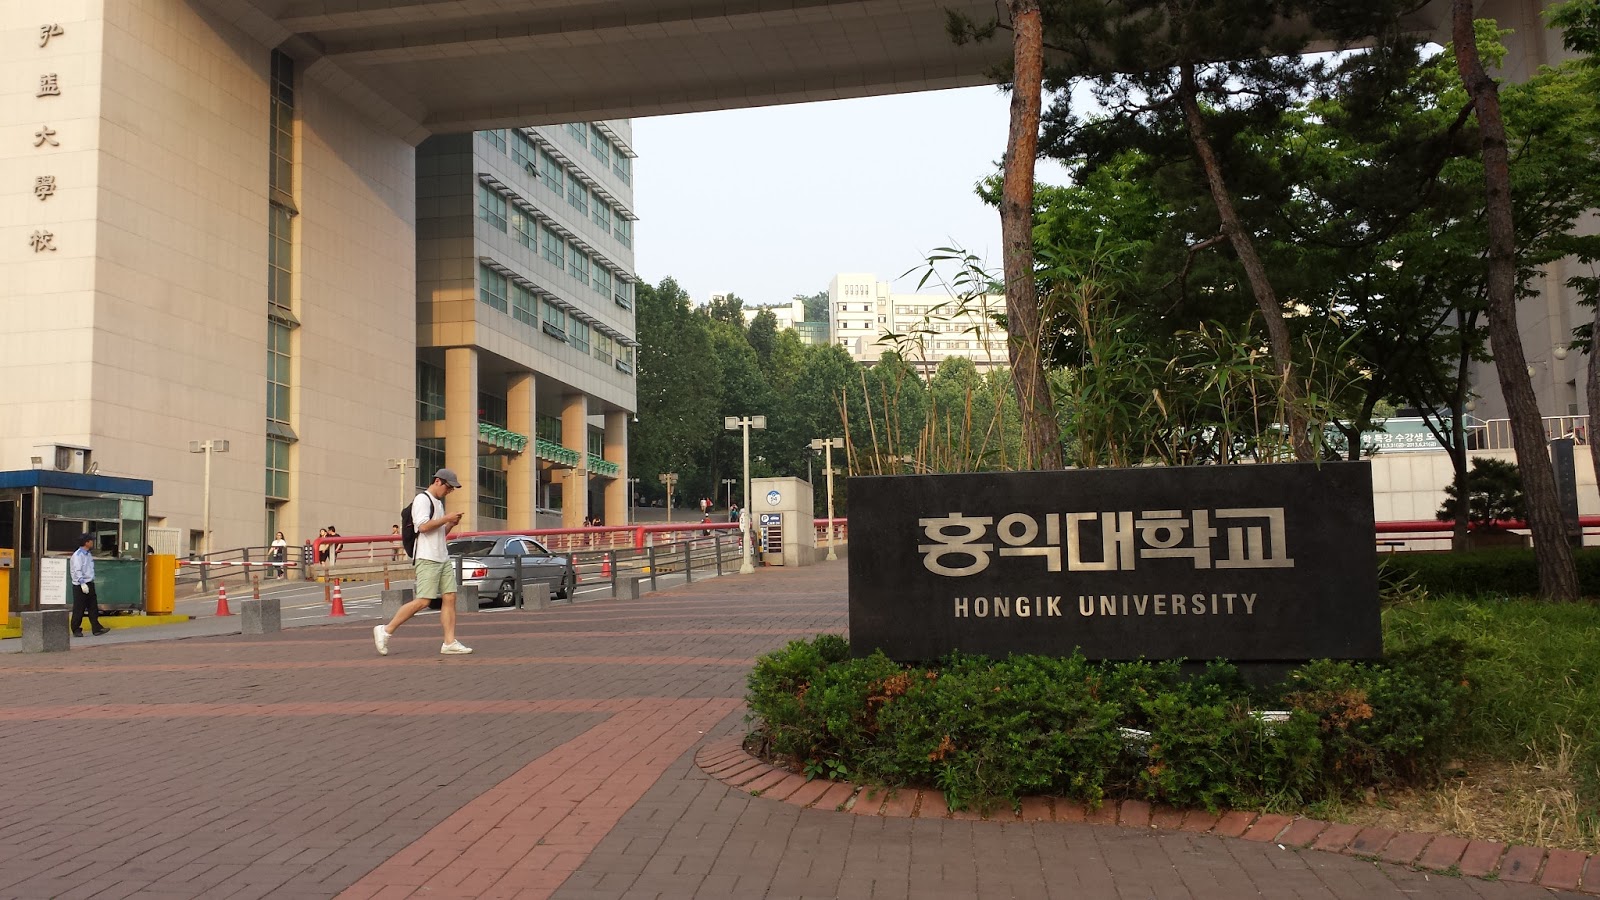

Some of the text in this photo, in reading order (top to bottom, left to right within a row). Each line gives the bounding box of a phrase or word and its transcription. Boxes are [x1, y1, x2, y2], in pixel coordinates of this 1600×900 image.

[1374, 433, 1393, 443] 특강
[1395, 432, 1424, 443] 수강생
[918, 507, 1295, 577] 홍익대학교
[954, 593, 1258, 618] HONGIK UNIVERSITY
